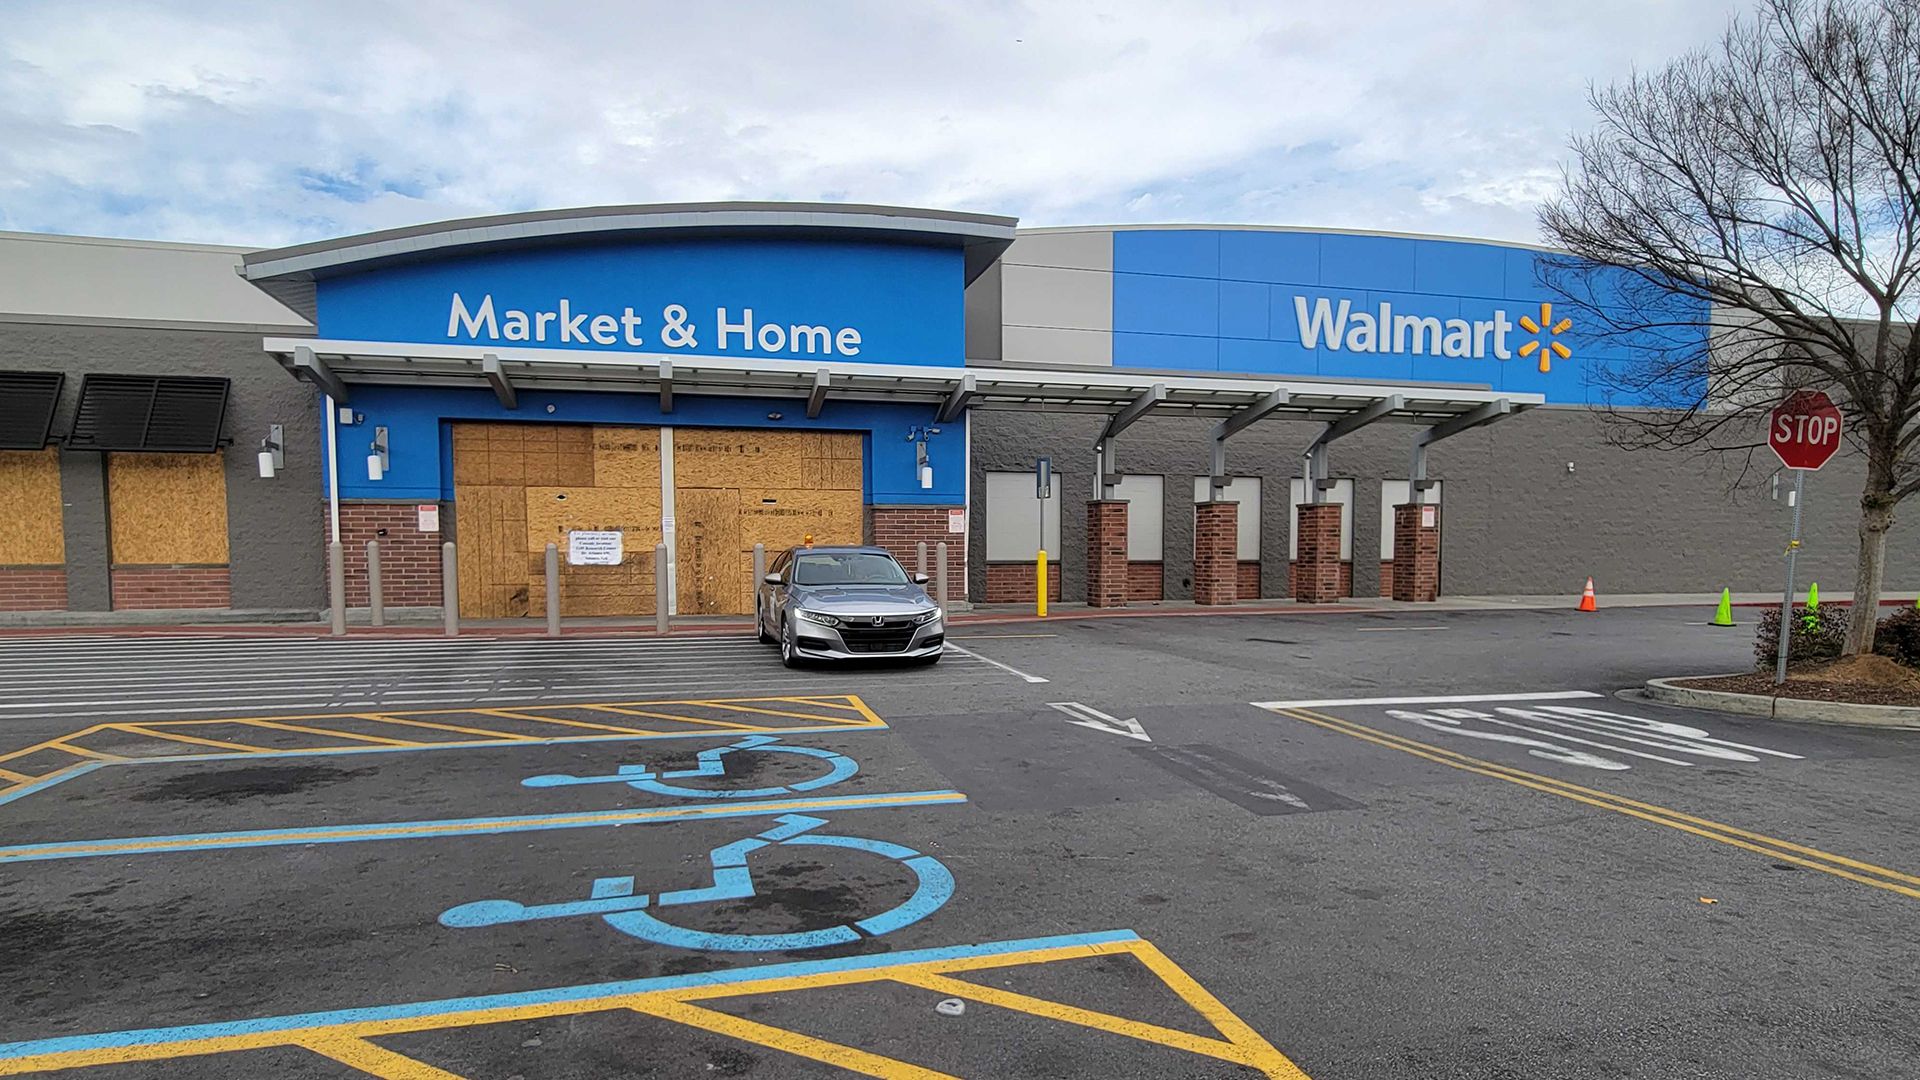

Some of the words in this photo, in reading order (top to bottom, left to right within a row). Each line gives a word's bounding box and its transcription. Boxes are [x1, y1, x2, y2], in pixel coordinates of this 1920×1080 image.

[447, 292, 643, 347] Market
[660, 303, 698, 349] &
[716, 306, 862, 356] Home
[1293, 296, 1512, 360] Walmart
[1774, 413, 1838, 446] STOP
[1385, 705, 1806, 771] STOP
